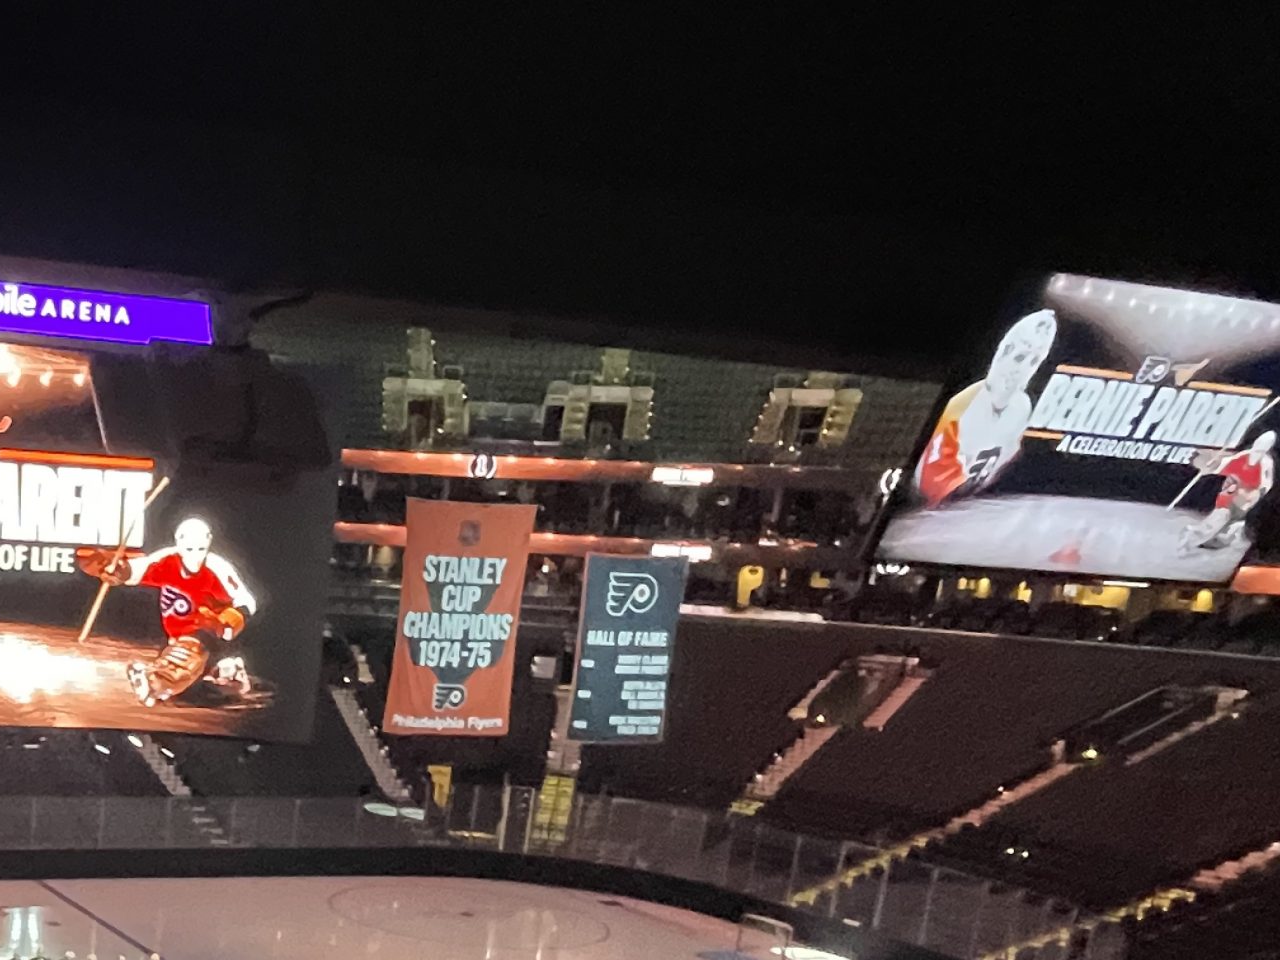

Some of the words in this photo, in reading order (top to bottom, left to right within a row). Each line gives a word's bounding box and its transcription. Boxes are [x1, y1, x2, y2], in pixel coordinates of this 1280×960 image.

[40, 299, 131, 326] ARENA
[1028, 373, 1156, 438] BERNIE
[1133, 386, 1269, 449] PARENT
[1055, 434, 1072, 453] A
[1071, 436, 1155, 461] CELEBRATION
[1150, 444, 1172, 463] OF
[1167, 446, 1198, 465] LIFE
[30, 546, 76, 574] LIFE
[423, 555, 508, 585] STANLEY
[441, 584, 482, 612] CUP
[403, 611, 513, 640] CHAMPIONS
[587, 630, 616, 646] HALL
[617, 631, 634, 647] OF
[634, 631, 668, 647] FAME
[419, 641, 492, 668] 1974-75
[392, 714, 465, 731] Philadelphia
[467, 716, 503, 731] Flyers
